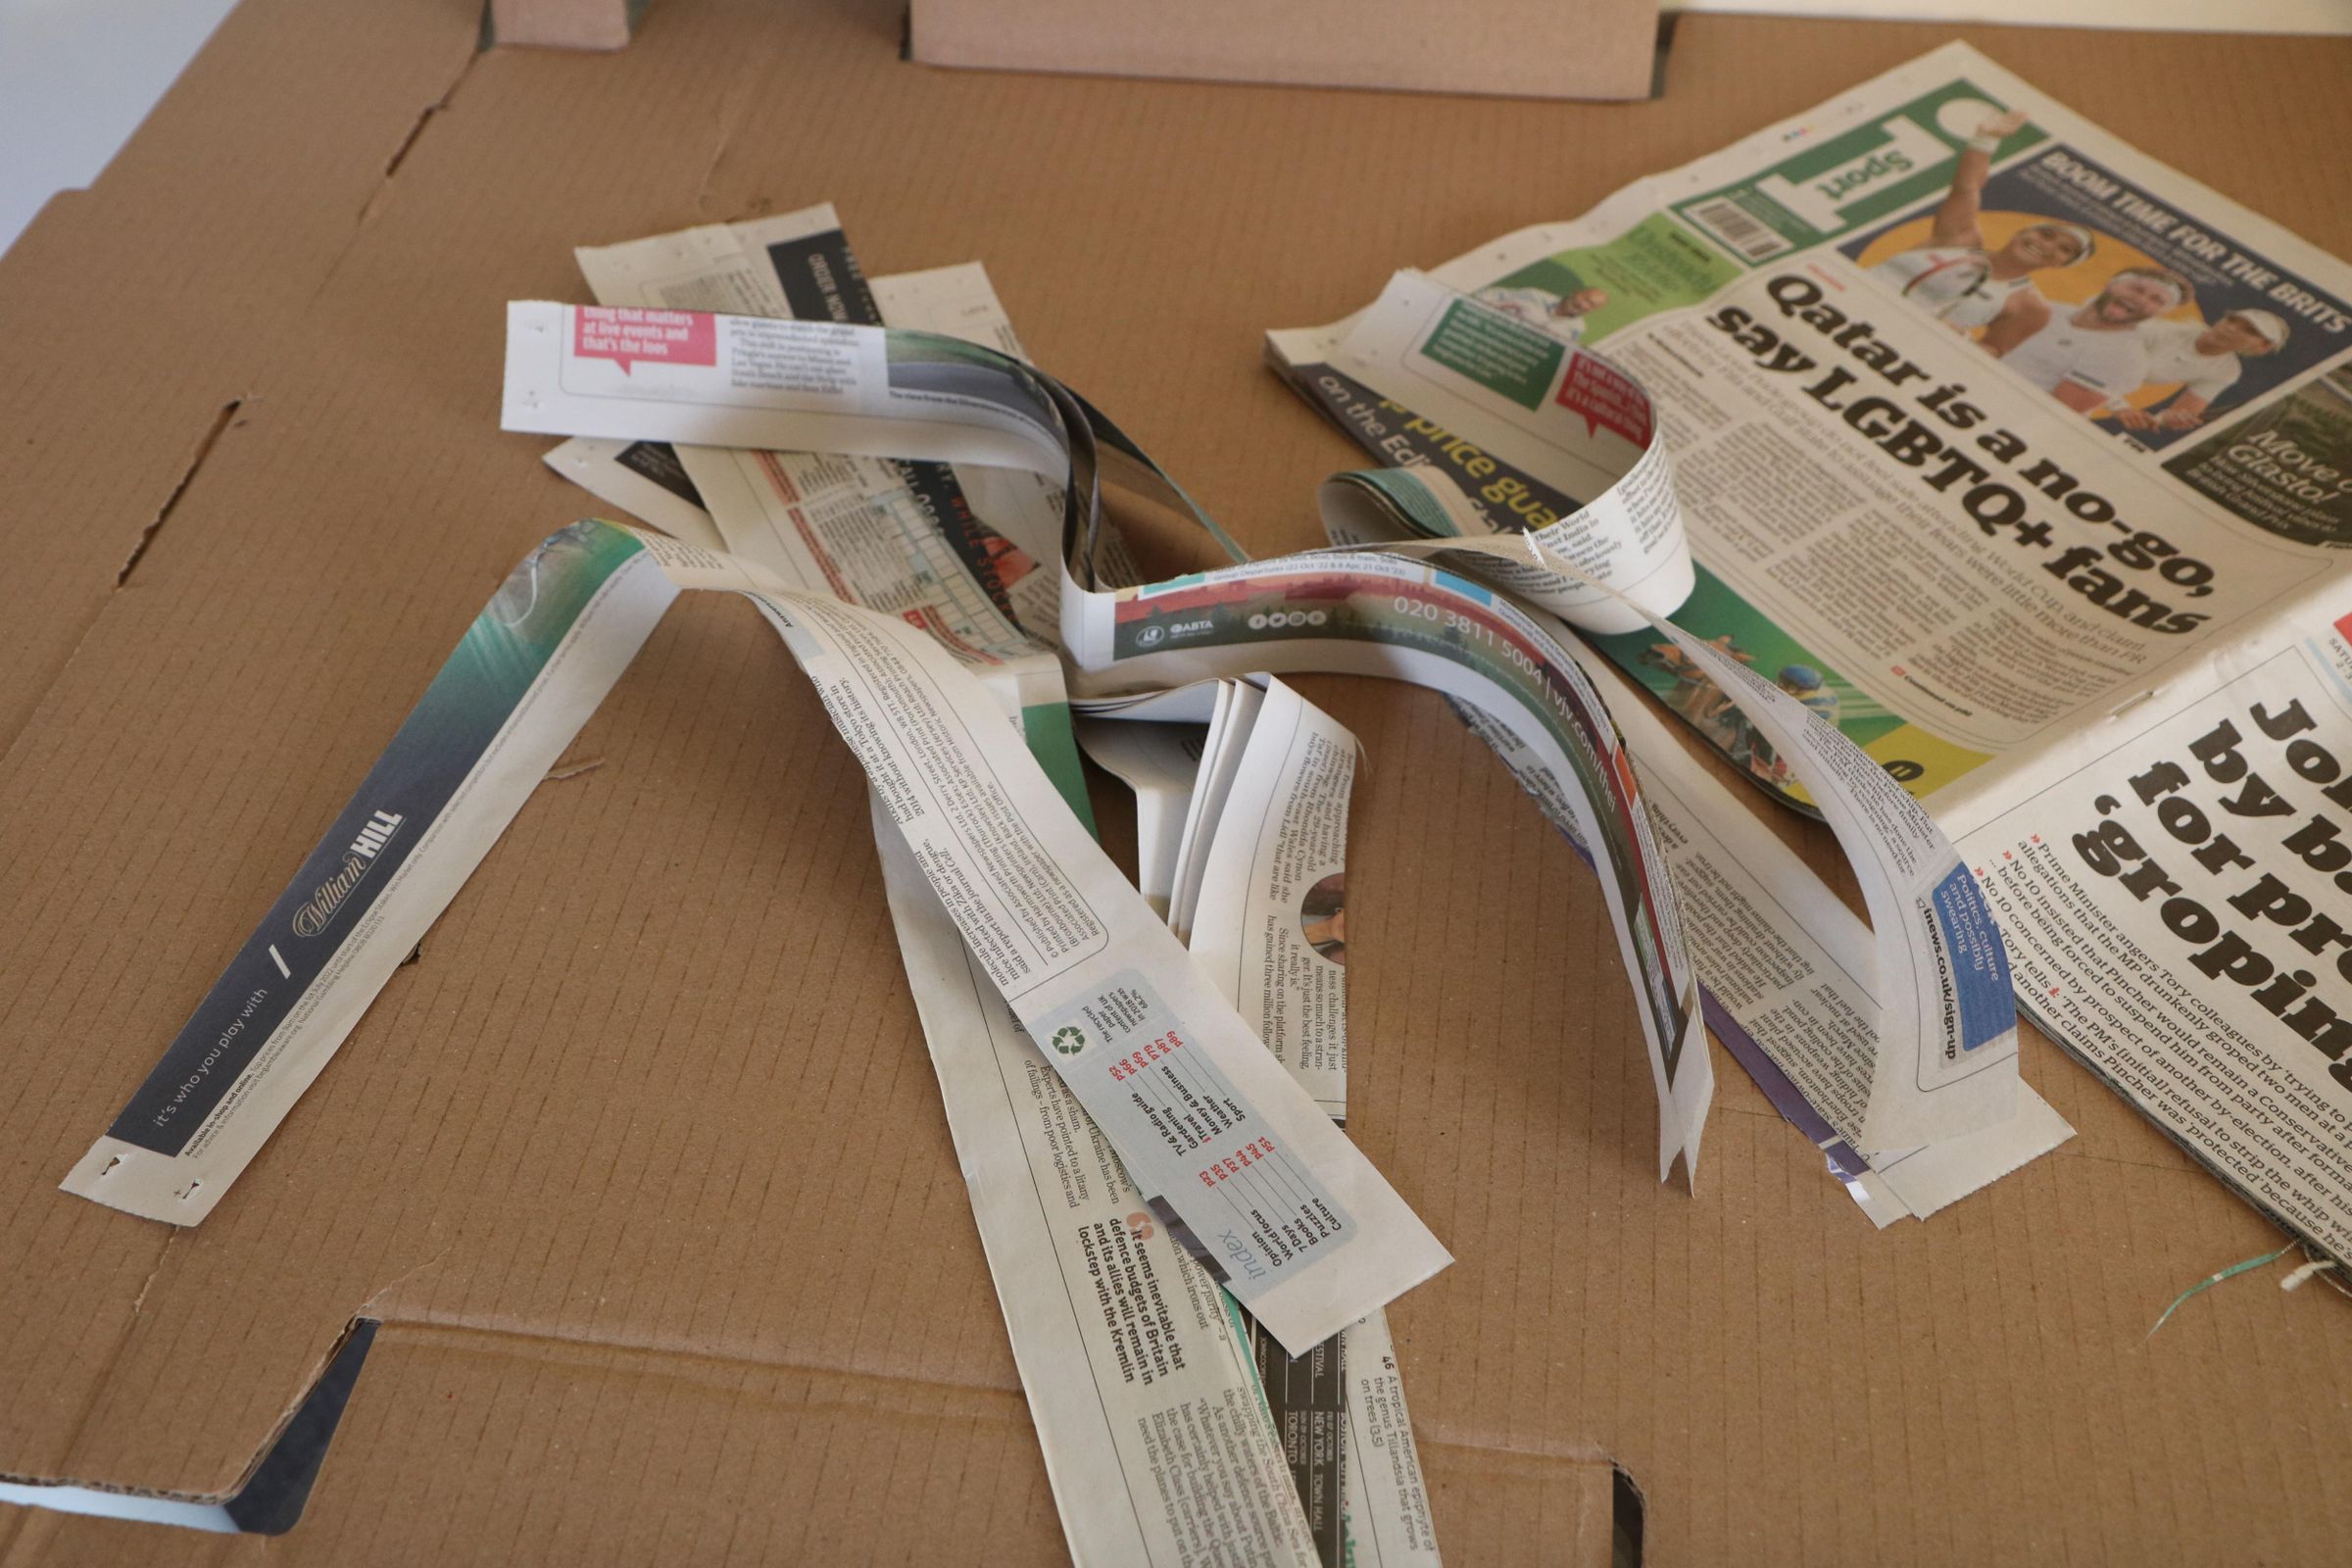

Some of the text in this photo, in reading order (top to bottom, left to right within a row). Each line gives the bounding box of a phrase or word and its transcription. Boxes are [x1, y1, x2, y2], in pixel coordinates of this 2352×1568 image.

[1817, 151, 1914, 201] Sport
[2041, 152, 2352, 332] BOOM TIME FOR THE BRITS
[664, 327, 688, 340] and
[1319, 376, 1351, 403] on
[1346, 403, 1387, 436] the
[1767, 275, 1931, 386] Qatar
[1916, 384, 1986, 429] is
[1977, 429, 2028, 465] a
[2018, 459, 2215, 598] no-go,
[1706, 307, 2211, 634] say LGBTQ+ fans
[2228, 444, 2338, 504] Glasto!
[2247, 429, 2339, 481] Move
[1481, 476, 1558, 532] gua
[1183, 619, 1214, 633] ABTA
[1394, 596, 1439, 621] 020
[1445, 611, 1495, 647] 3811
[1501, 640, 1543, 684] 5004
[2187, 718, 2297, 817] by
[2129, 760, 2255, 875] for
[292, 810, 403, 937] William HILL
[1940, 891, 1968, 955] swearing
[1949, 883, 1984, 971] and possibly
[1957, 874, 1998, 981] Politics, culture
[1082, 1005, 1113, 1043] The recycled
[1098, 995, 1108, 1005] UK
[1098, 1010, 1116, 1028] paper
[1108, 992, 1138, 1026] newspapers
[1110, 1010, 1131, 1034] content
[1117, 988, 1129, 1001] was
[1125, 999, 1141, 1014] 2018
[1130, 989, 1149, 1009] 68.2%
[1326, 992, 1339, 1041] challenges
[1923, 907, 1957, 1059] inews.co.uk/sign-up
[2018, 842, 2346, 1142] allegations that the MP drunkenly groped two men at a
[2037, 843, 2345, 1123] Prime Minister angers Tory colleagues by ‘trying to
[153, 989, 268, 1127] it's who you play with
[1132, 1052, 1149, 1068] p69
[1144, 1045, 1222, 1135] Money & Business p79
[1154, 1038, 1233, 1129] Weather p87
[1166, 1031, 1246, 1122] Sport p89
[1326, 1052, 1339, 1070] just
[1108, 1065, 1187, 1156] TV & Radio guide p52
[1119, 1058, 1199, 1149] Gardening p66
[1183, 1113, 1207, 1141] Travel
[1222, 1157, 1240, 1173] p37
[1236, 1150, 1319, 1246] Books p44
[1246, 1143, 1331, 1239] Puzzles p45
[1257, 1137, 1342, 1231] Culture p51
[1199, 1171, 1282, 1267] Opinion p23
[1210, 1164, 1294, 1260] World focus p35
[1218, 1230, 1265, 1281] index
[1281, 1224, 1301, 1248] Days
[1078, 1226, 1135, 1383] lockstep with the Kremlin
[1094, 1223, 1153, 1386] and its allies will remain in
[1109, 1218, 1169, 1377] defence budgets of Britain
[1131, 1229, 1186, 1370] It seems inevitable that
[1288, 1410, 1298, 1464] TORONTO
[1313, 1411, 1325, 1531] NEW YORK TOWN HALL
[1382, 1356, 1395, 1370] 46
[1390, 1386, 1406, 1428] tropical
[1399, 1430, 1418, 1484] American
[1411, 1487, 1430, 1537] epiphyte
[1423, 1536, 1437, 1551] of
